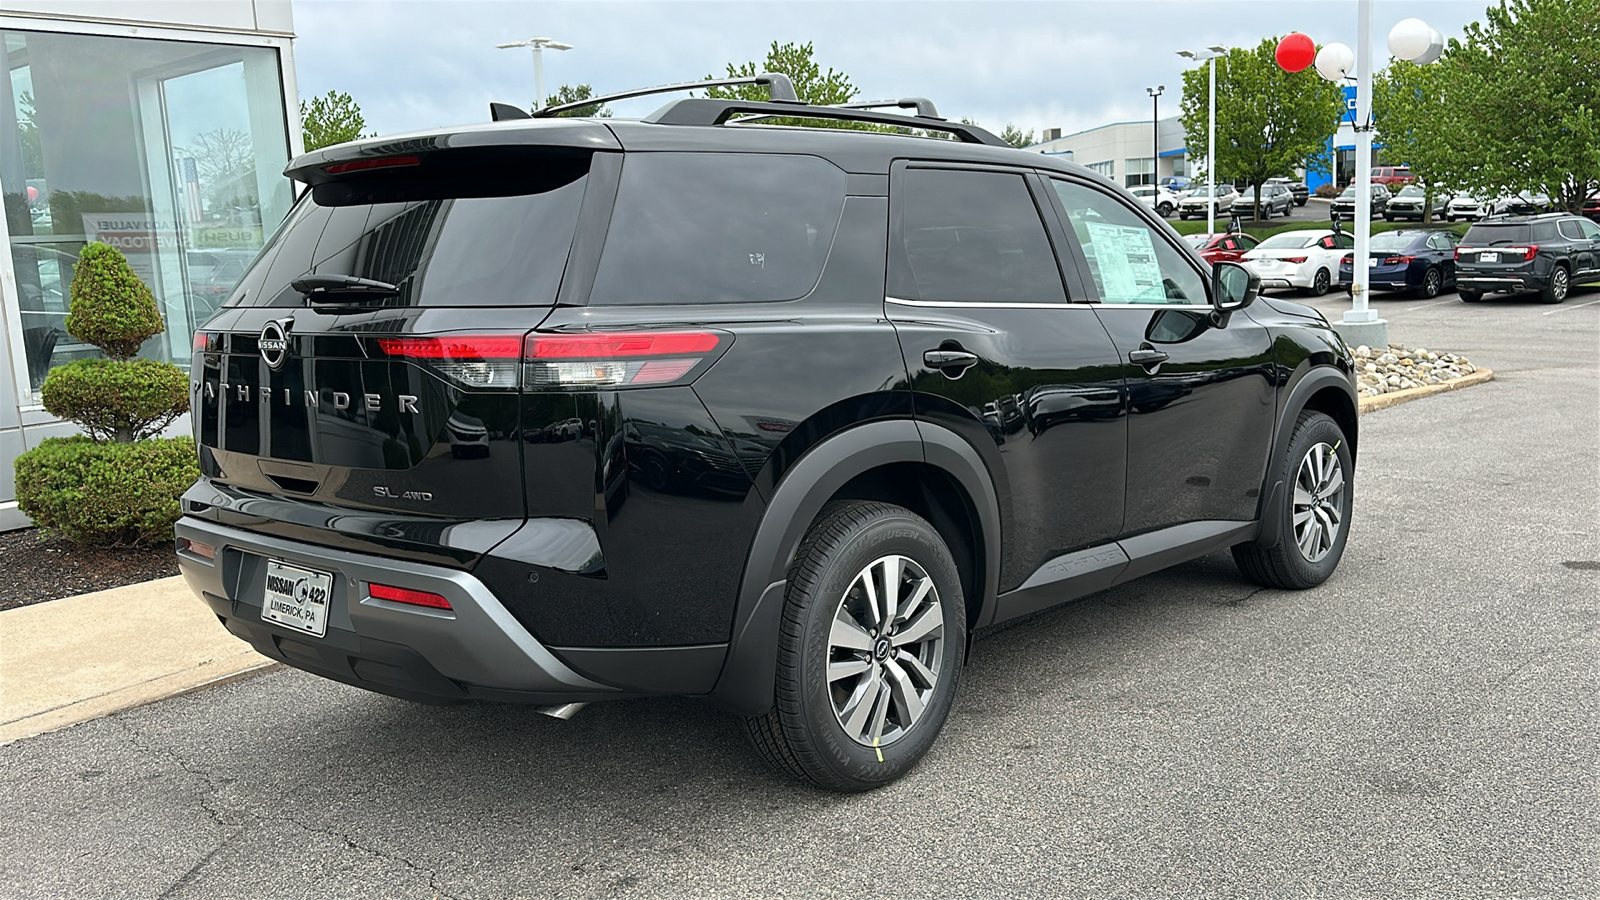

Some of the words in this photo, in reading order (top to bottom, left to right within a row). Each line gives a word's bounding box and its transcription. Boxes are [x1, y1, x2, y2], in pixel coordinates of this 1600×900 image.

[258, 339, 287, 350] NISSAN
[193, 379, 420, 415] PATHFINDER
[372, 485, 400, 498] SL
[402, 490, 433, 502] 4WD
[1047, 549, 1123, 573] PATHFINDER
[267, 575, 294, 597] NISSAN
[309, 587, 326, 605] 422
[271, 600, 304, 619] LIMERICK,
[305, 610, 316, 622] PA
